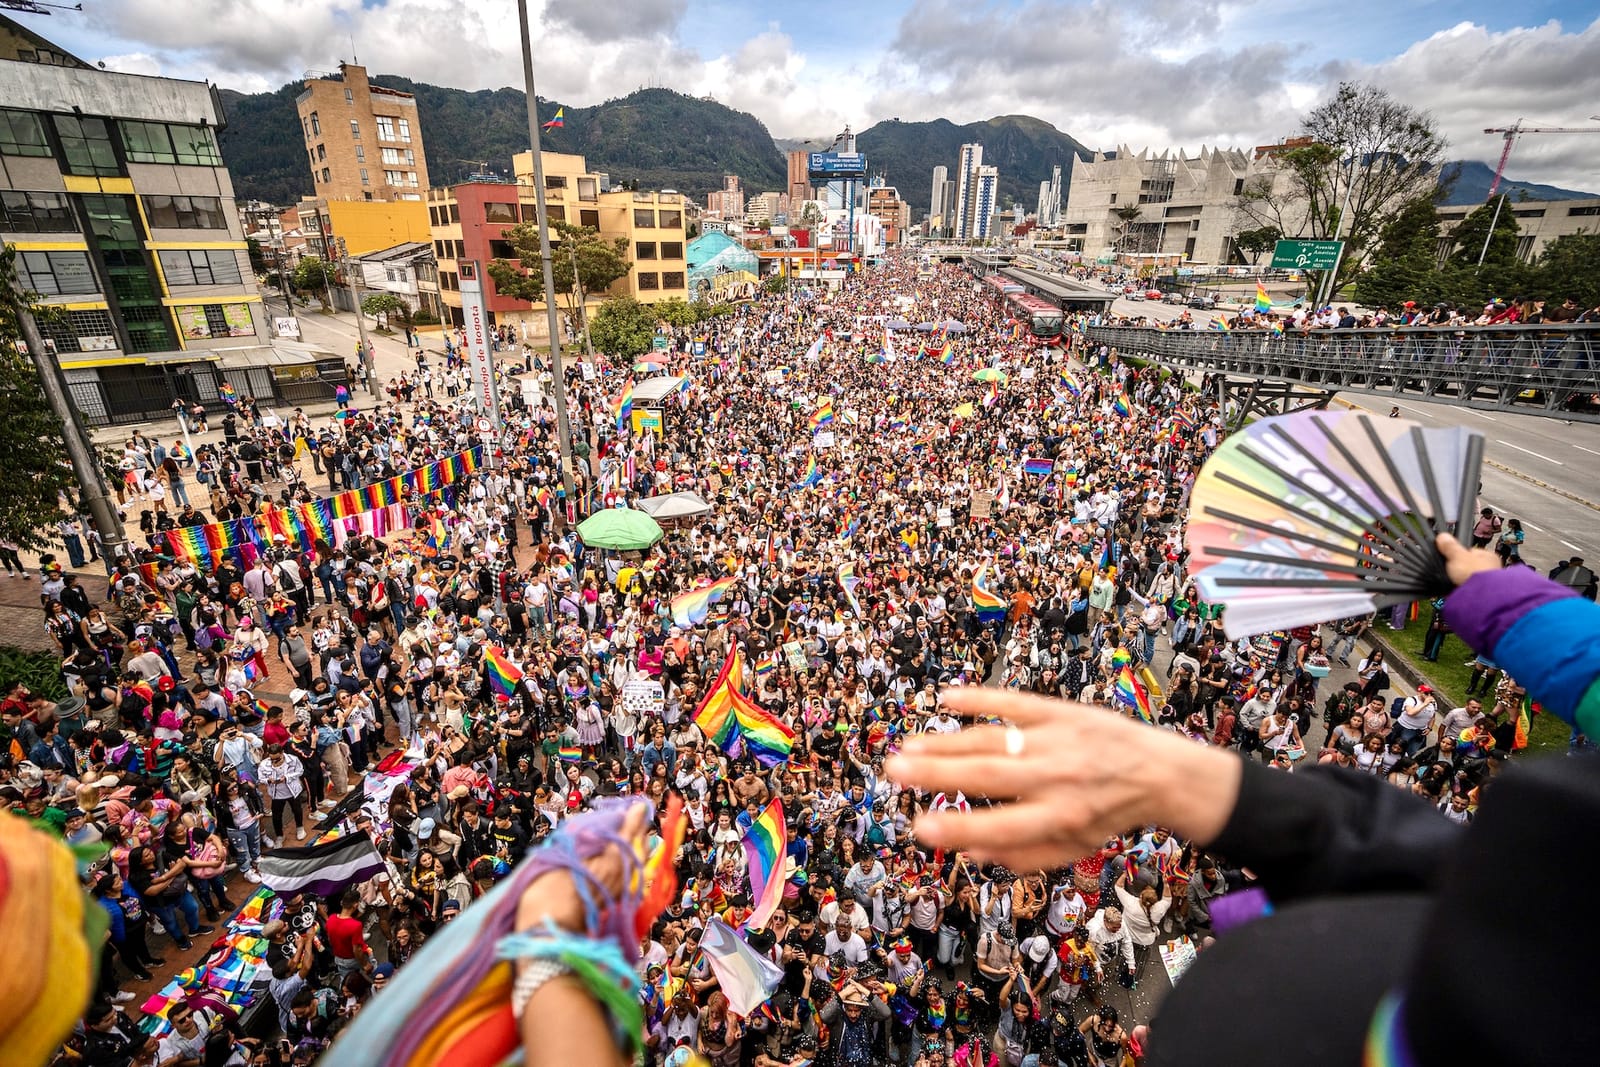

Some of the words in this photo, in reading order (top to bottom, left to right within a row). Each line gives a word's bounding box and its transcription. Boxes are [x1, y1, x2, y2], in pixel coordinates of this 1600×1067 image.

[471, 305, 482, 344] Bogotá
[477, 349, 485, 362] de
[481, 366, 492, 406] Concejo
